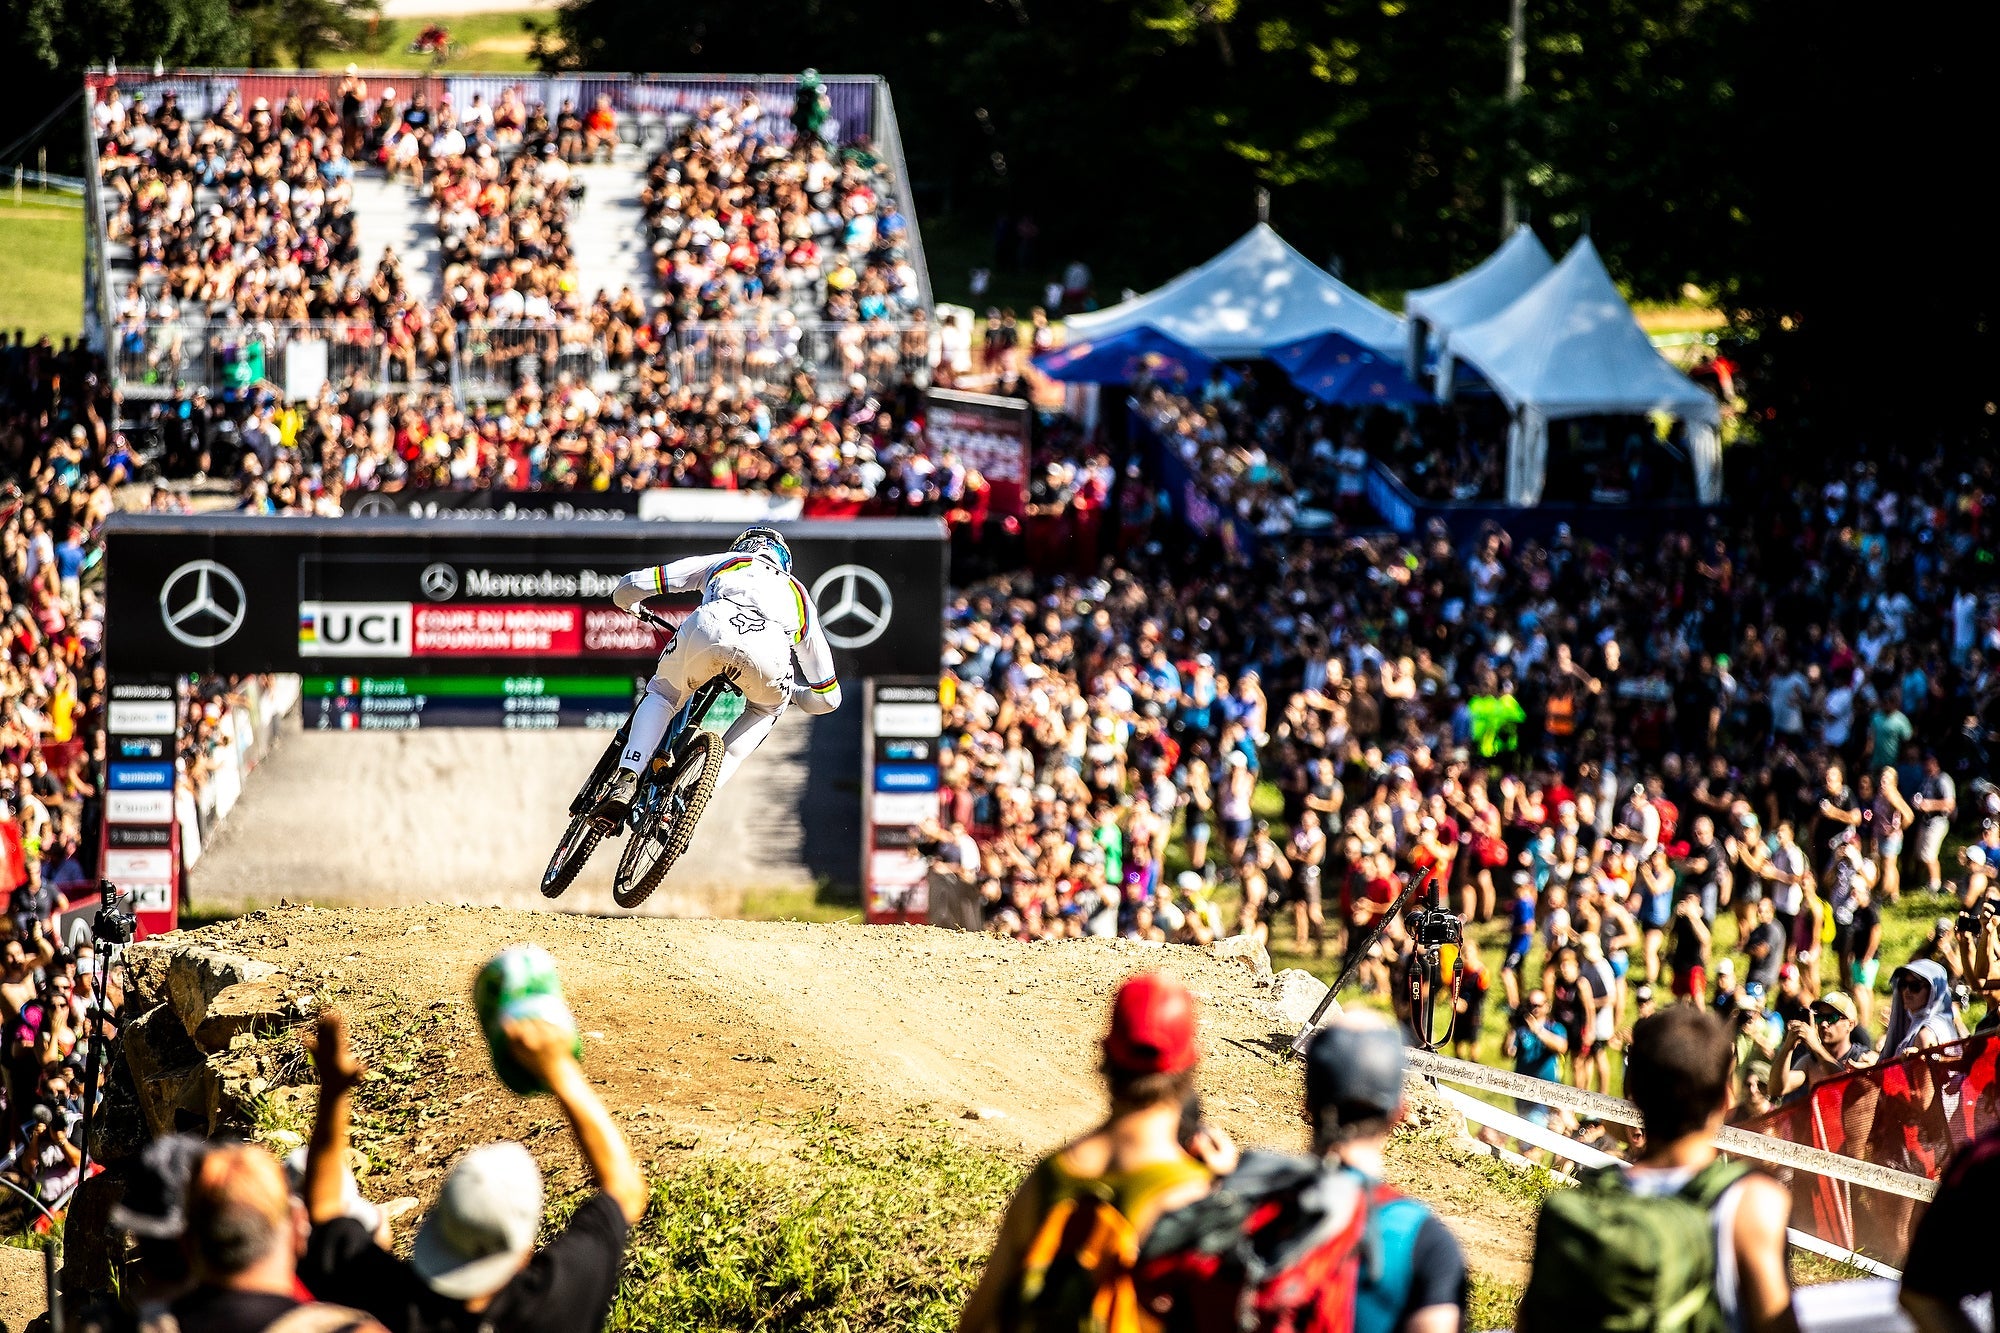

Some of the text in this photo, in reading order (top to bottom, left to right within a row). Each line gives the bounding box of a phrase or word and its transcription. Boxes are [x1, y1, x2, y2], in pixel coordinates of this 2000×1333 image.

[466, 568, 621, 597] Mercedes-Ben
[320, 614, 400, 645] UCI
[504, 610, 574, 632] MONDE
[416, 630, 551, 650] MOUNTAIN BIKE
[585, 630, 657, 650] CANADA
[625, 749, 642, 762] LB
[1412, 981, 1420, 1001] EOS
[1486, 1073, 1526, 1093] Mercedes-Benz
